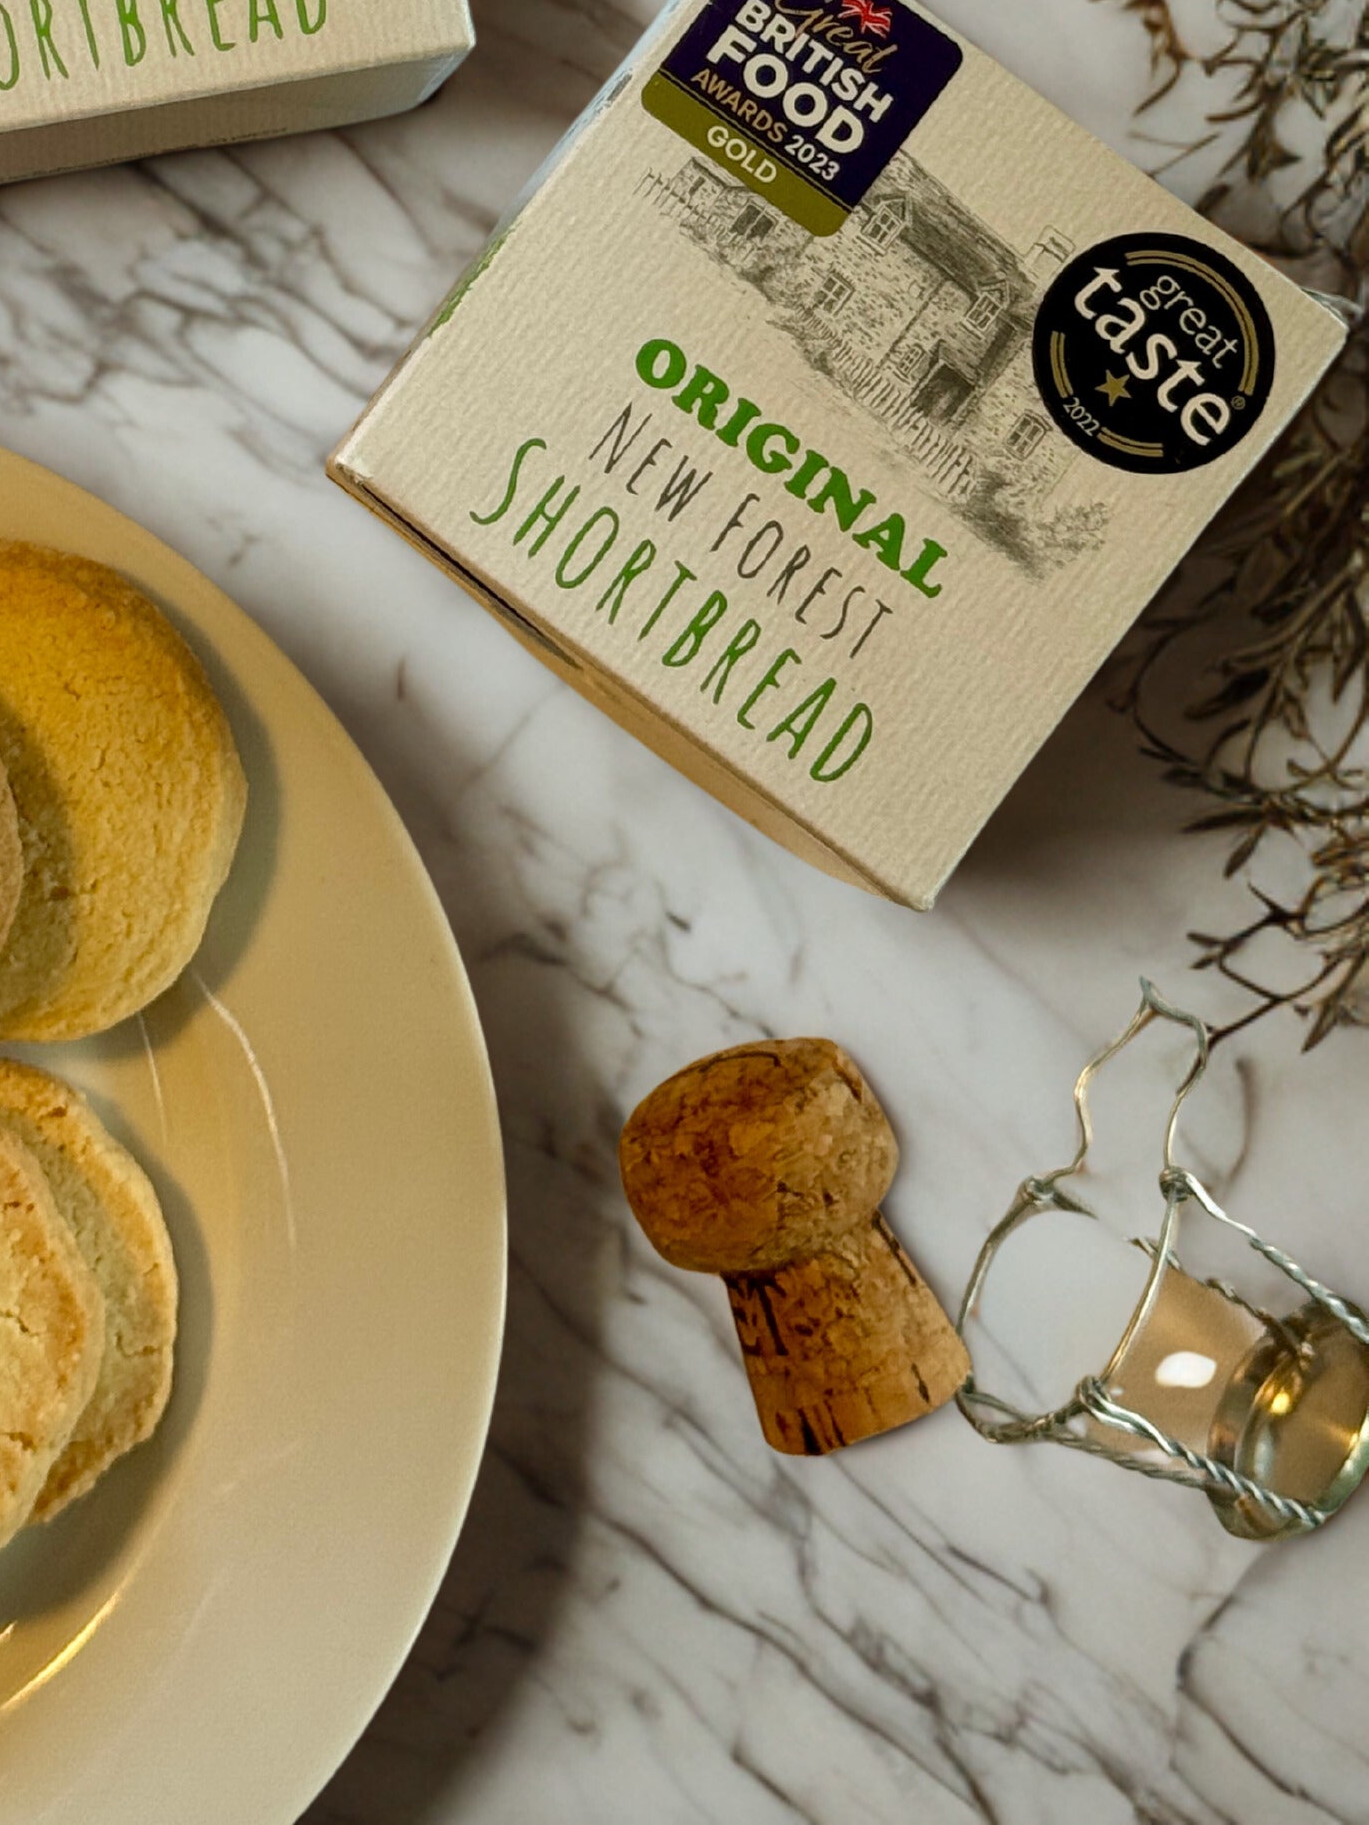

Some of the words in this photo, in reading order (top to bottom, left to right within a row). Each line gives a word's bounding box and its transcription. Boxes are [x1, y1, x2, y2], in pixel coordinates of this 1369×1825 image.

[690, 68, 789, 141] AWARDS
[784, 134, 841, 181] 2023
[706, 25, 865, 154] FOOD
[707, 125, 777, 184] GOLD
[1074, 266, 1231, 446] taste
[1139, 275, 1239, 369] great
[635, 339, 948, 598] ORIGINAL
[1062, 397, 1100, 437] 2022
[588, 402, 714, 522] NEW
[710, 493, 893, 659] FOREST
[469, 438, 873, 783] SHORTBREAD
